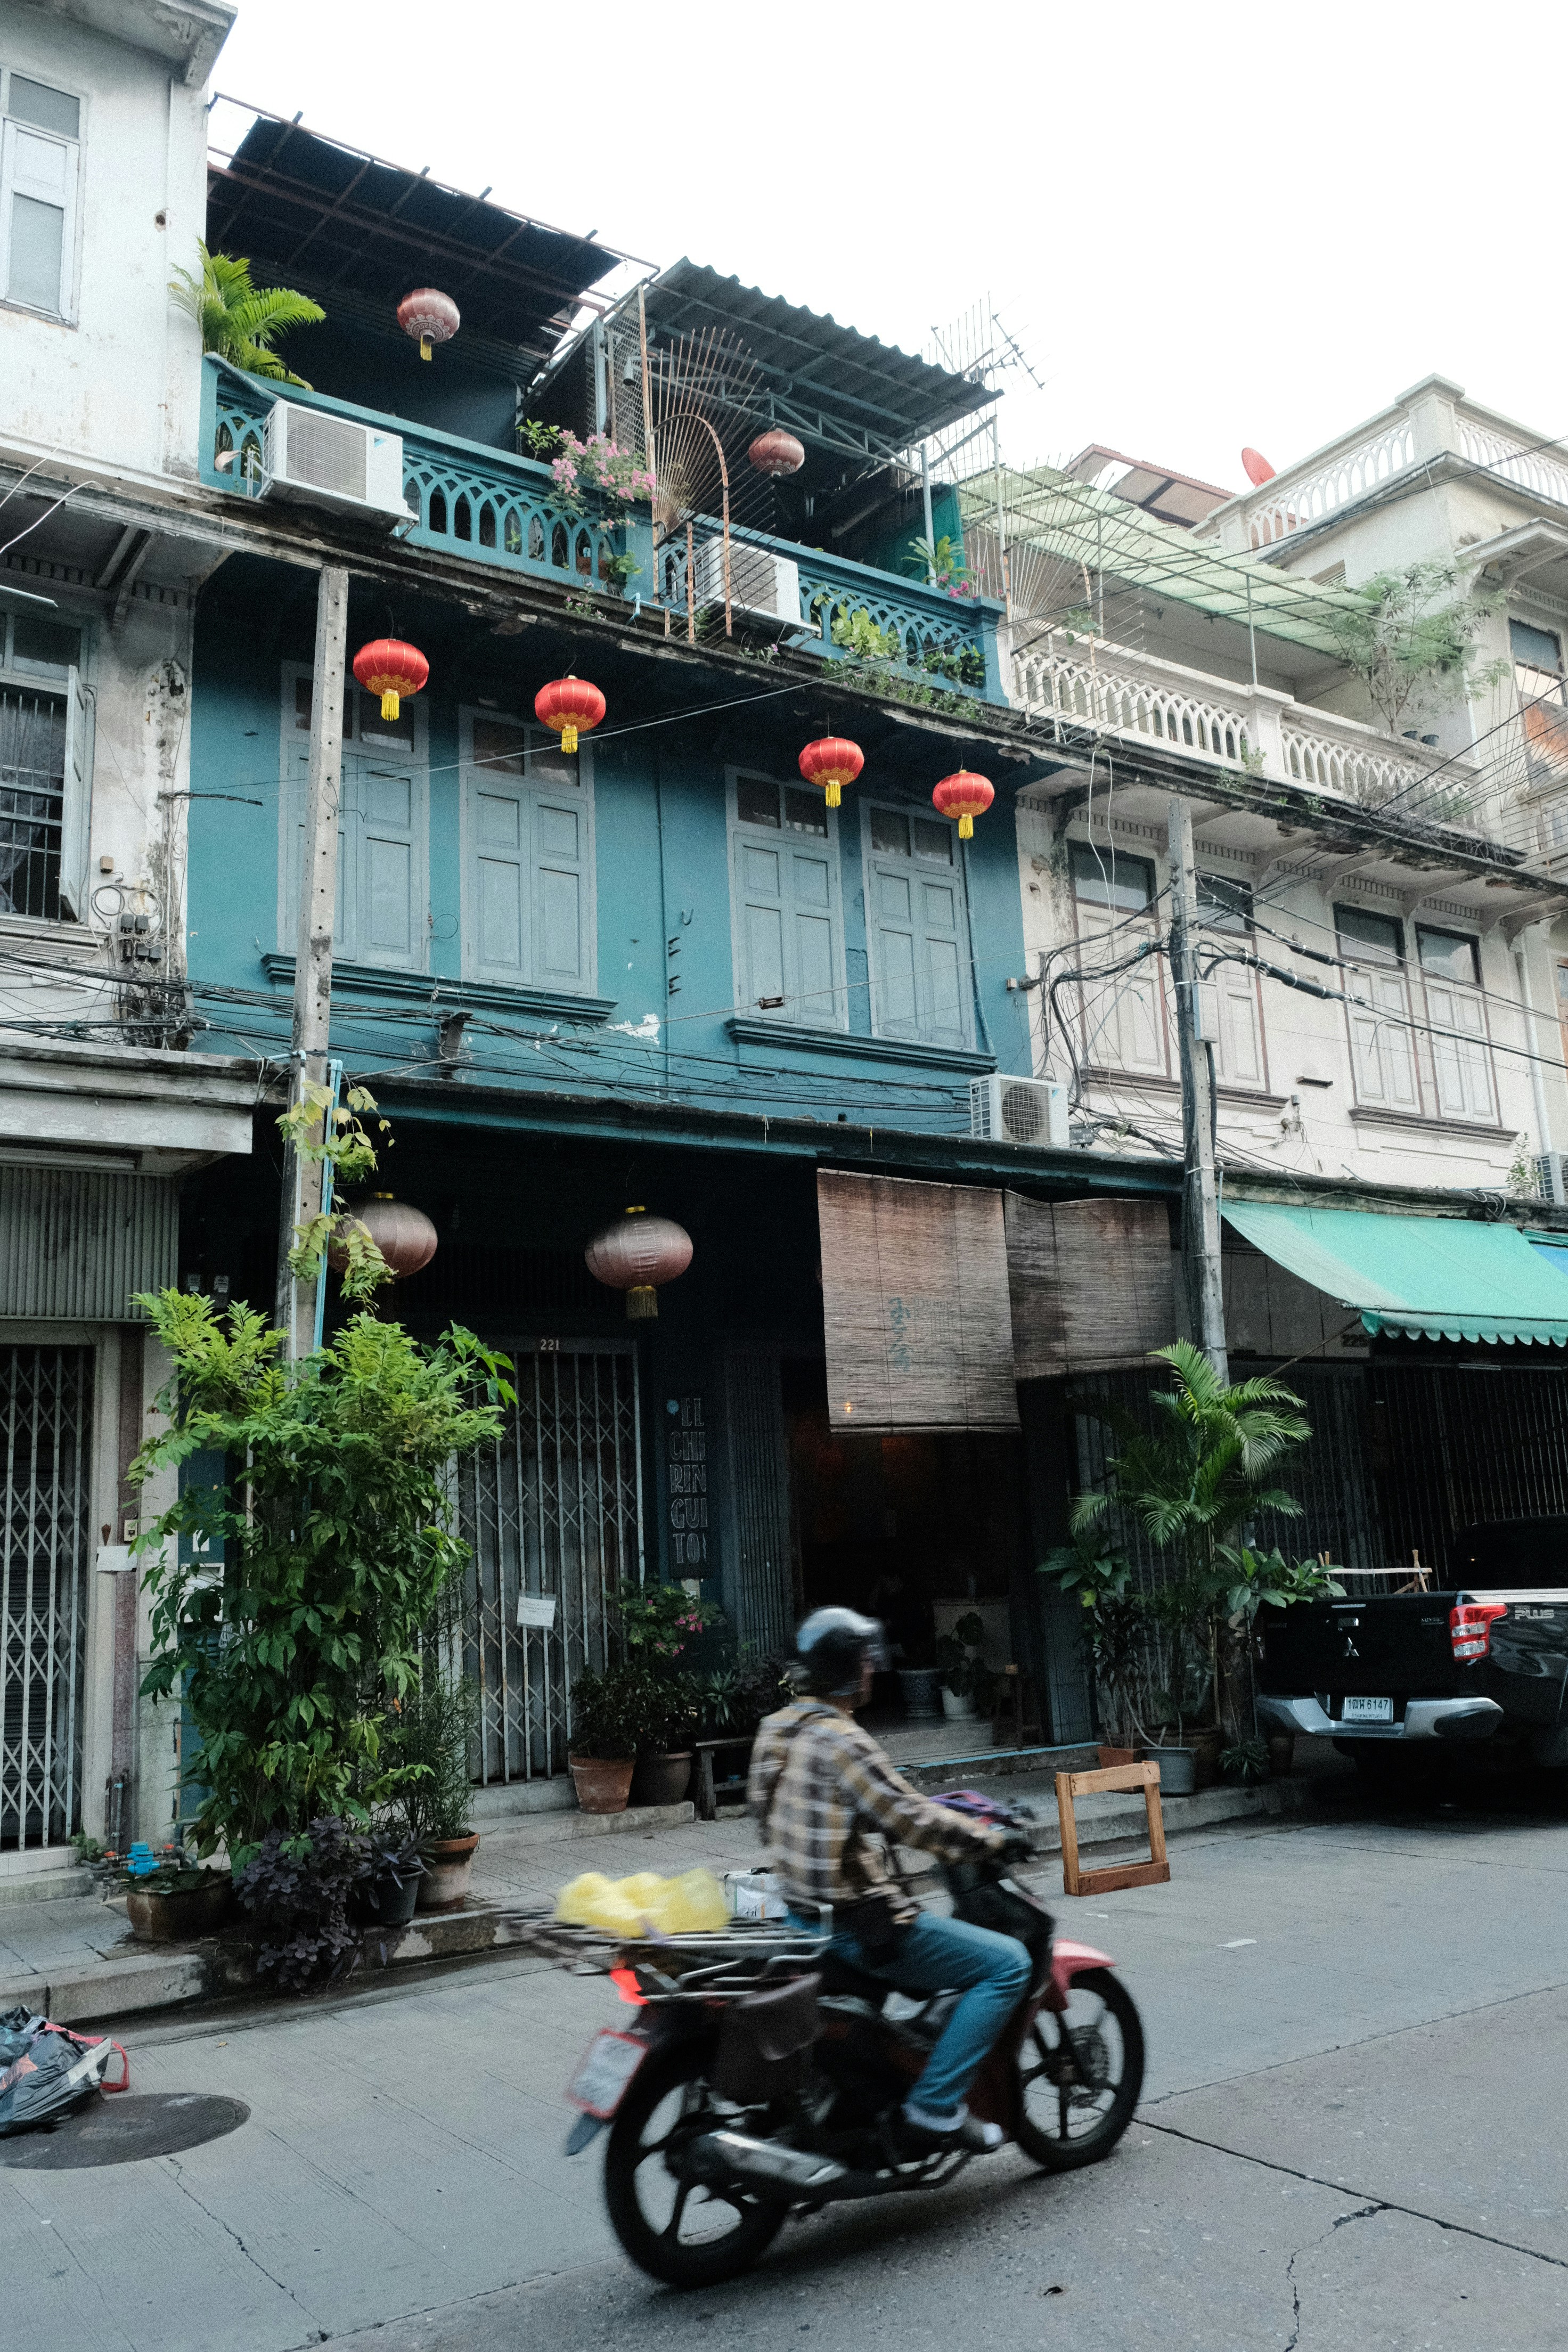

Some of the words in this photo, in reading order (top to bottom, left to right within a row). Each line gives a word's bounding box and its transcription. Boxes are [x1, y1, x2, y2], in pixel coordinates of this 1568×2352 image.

[540, 1338, 560, 1351] 221
[681, 1398, 704, 1427] EL
[669, 1431, 706, 1461] CHI
[669, 1464, 707, 1493] RIN
[671, 1498, 708, 1529] GUI
[1515, 1609, 1554, 1620] PLUS
[1367, 1699, 1389, 1710] 6147
